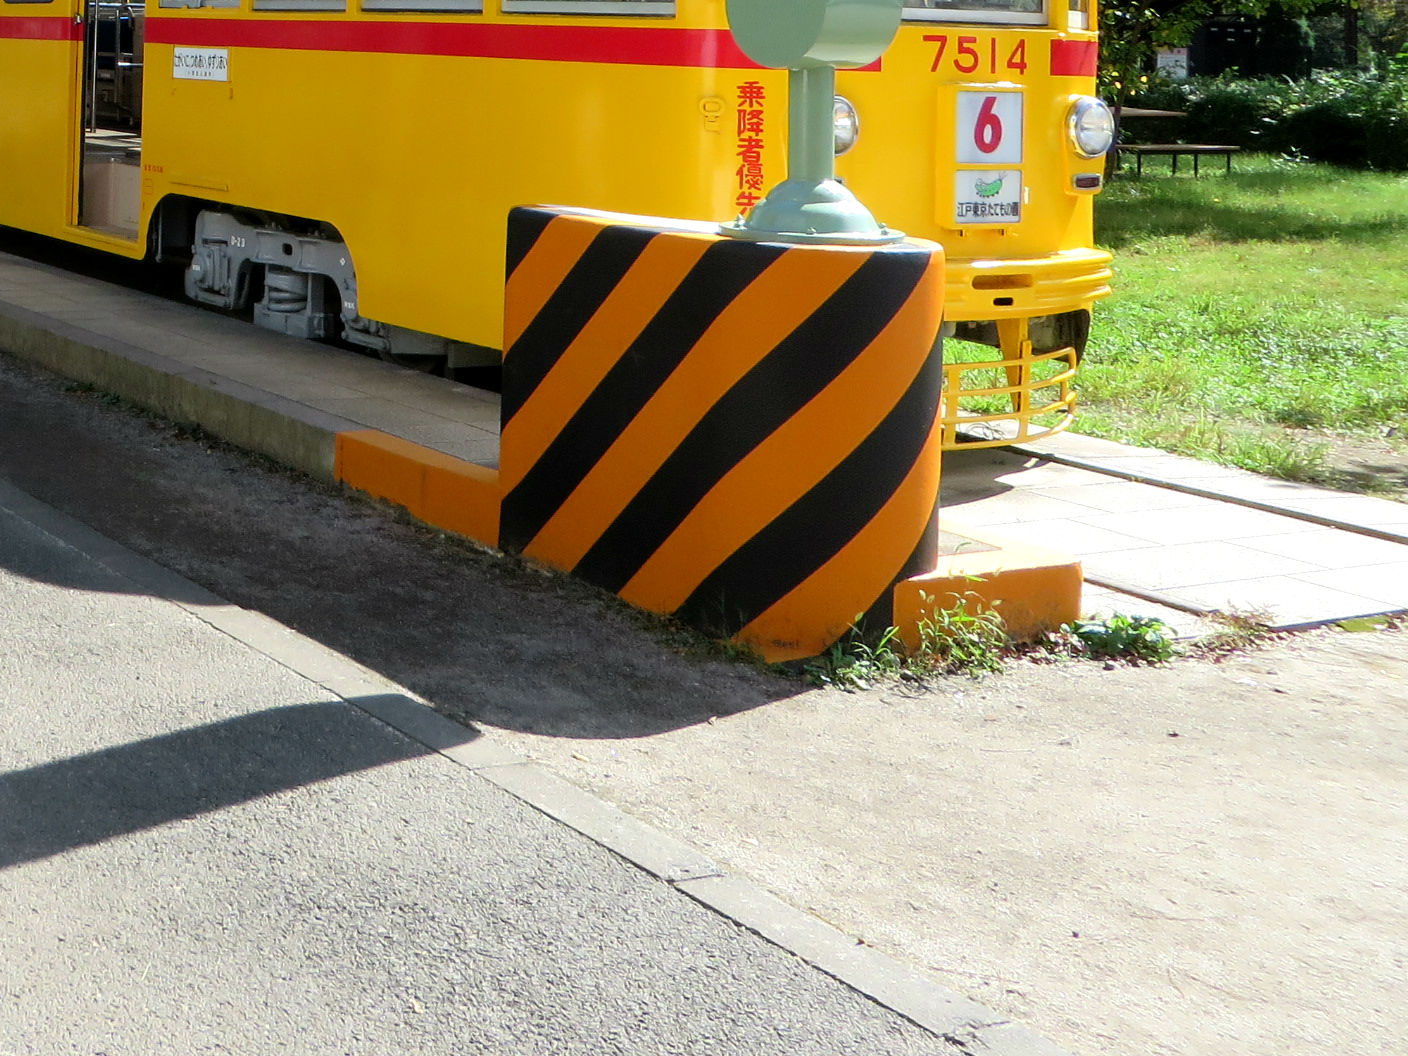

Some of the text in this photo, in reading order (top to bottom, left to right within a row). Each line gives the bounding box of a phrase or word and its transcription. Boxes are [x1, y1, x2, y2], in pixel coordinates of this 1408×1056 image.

[922, 34, 1027, 75] 7514
[736, 81, 766, 215] 乗降者優先
[974, 96, 1003, 153] 6
